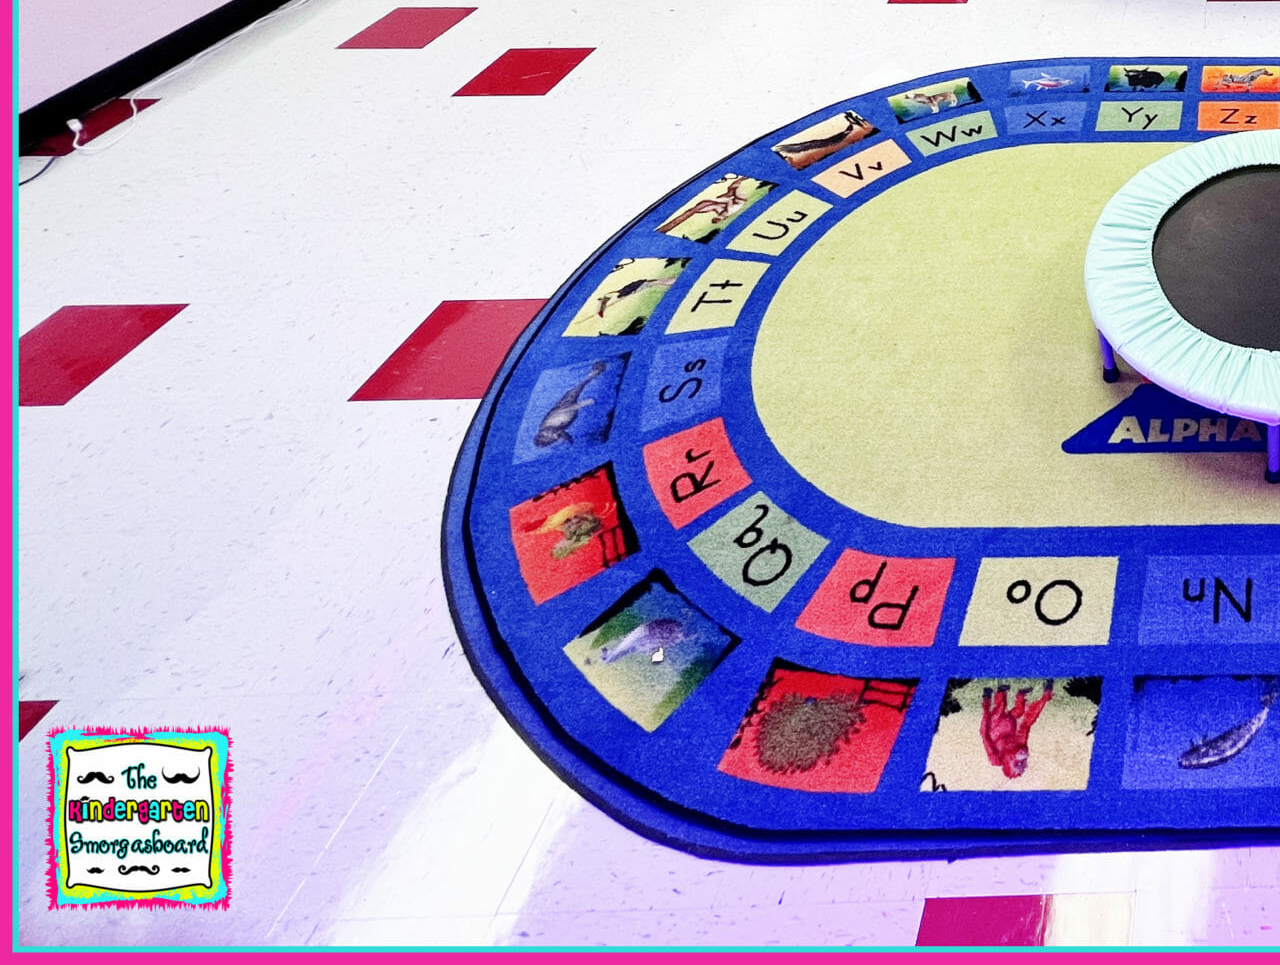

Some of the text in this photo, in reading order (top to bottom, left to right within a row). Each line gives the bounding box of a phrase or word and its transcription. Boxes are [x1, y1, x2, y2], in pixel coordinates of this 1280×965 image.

[1024, 110, 1067, 129] Xx
[1120, 106, 1160, 130] Yy
[1219, 108, 1258, 125] Zz
[920, 124, 985, 148] Ww
[838, 159, 884, 183] Vv
[752, 209, 809, 241] Uu
[690, 279, 744, 312] Tt
[658, 357, 707, 404] Ss
[668, 447, 722, 504] Rr
[732, 503, 793, 588] Qq
[848, 560, 920, 631] Pp
[1005, 579, 1083, 627] Oo
[1182, 576, 1254, 625] Nn
